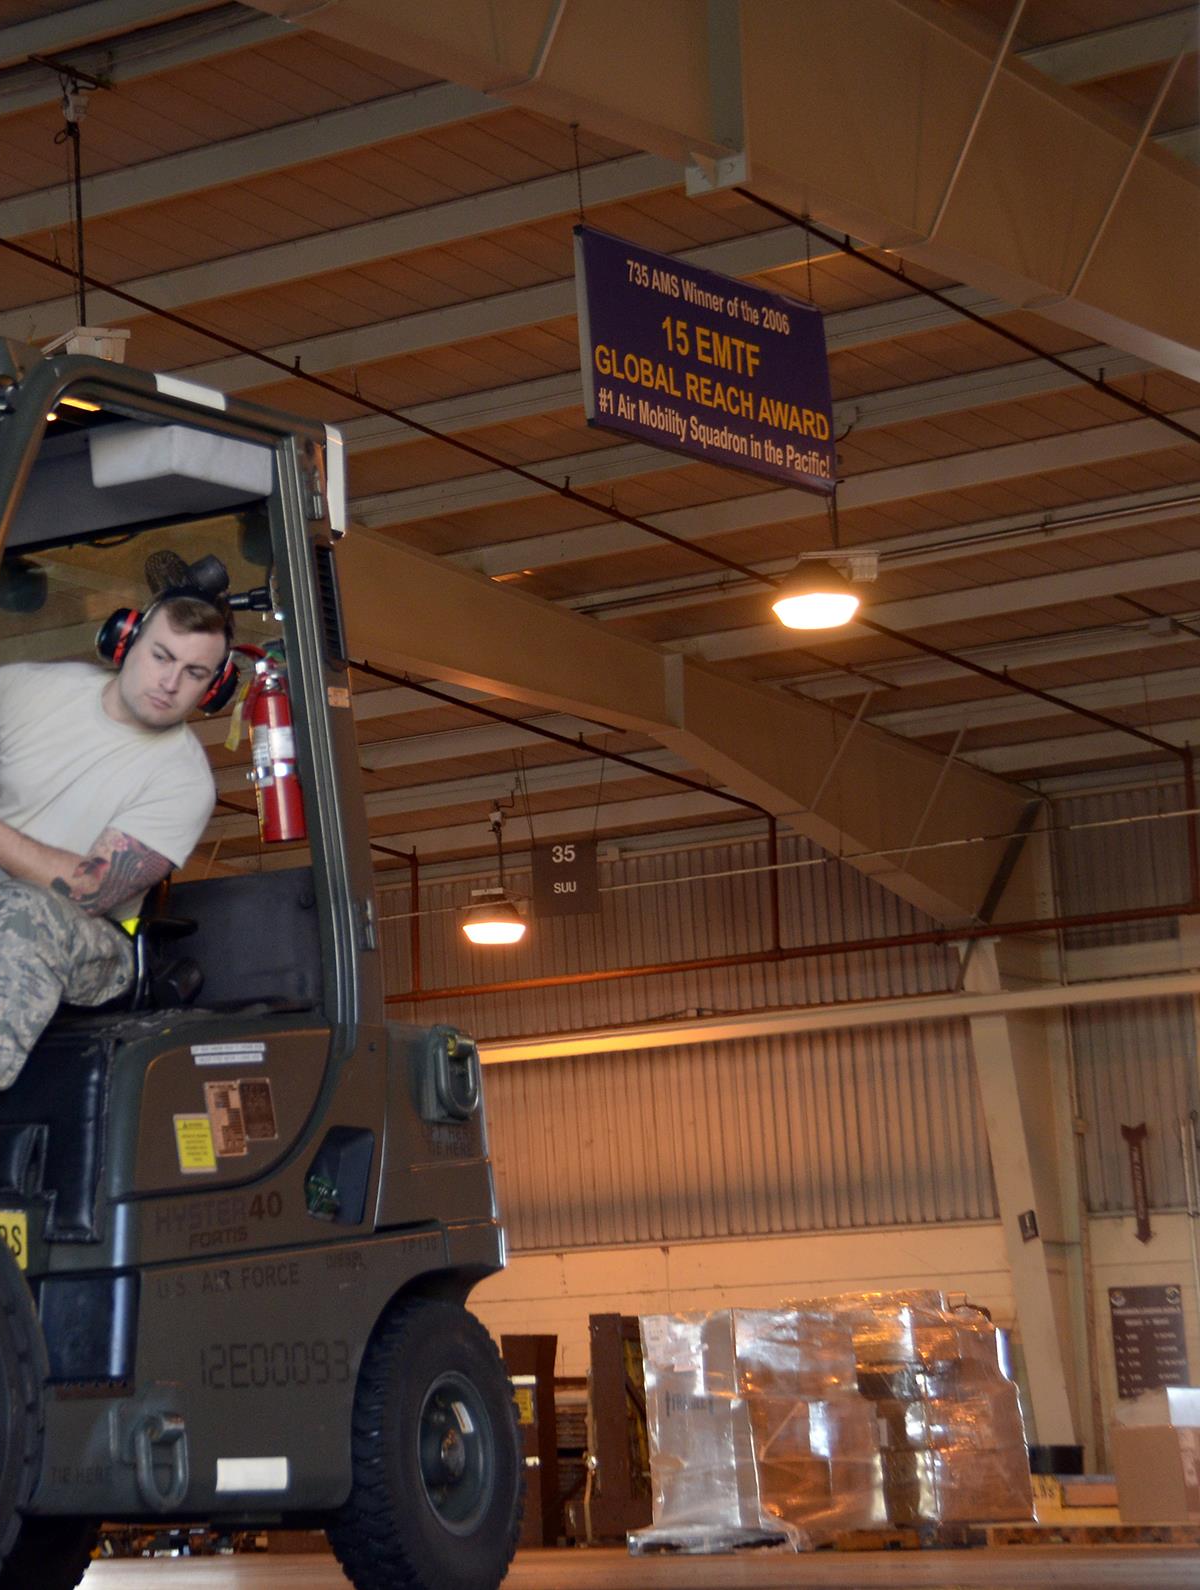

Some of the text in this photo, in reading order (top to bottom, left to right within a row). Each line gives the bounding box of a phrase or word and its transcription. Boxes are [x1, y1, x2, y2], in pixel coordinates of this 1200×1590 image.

[626, 260, 791, 336] 735 AMS Winner of the 2006
[661, 315, 761, 379] 15 EMTF
[594, 344, 831, 442] GLOBAL REACH AWARD
[598, 387, 831, 479] #1 Air Mobility Squadron in the Pacific!
[551, 845, 576, 863] 35
[553, 881, 577, 894] SUU
[249, 1190, 283, 1220] 40
[240, 1262, 300, 1290] FORCE
